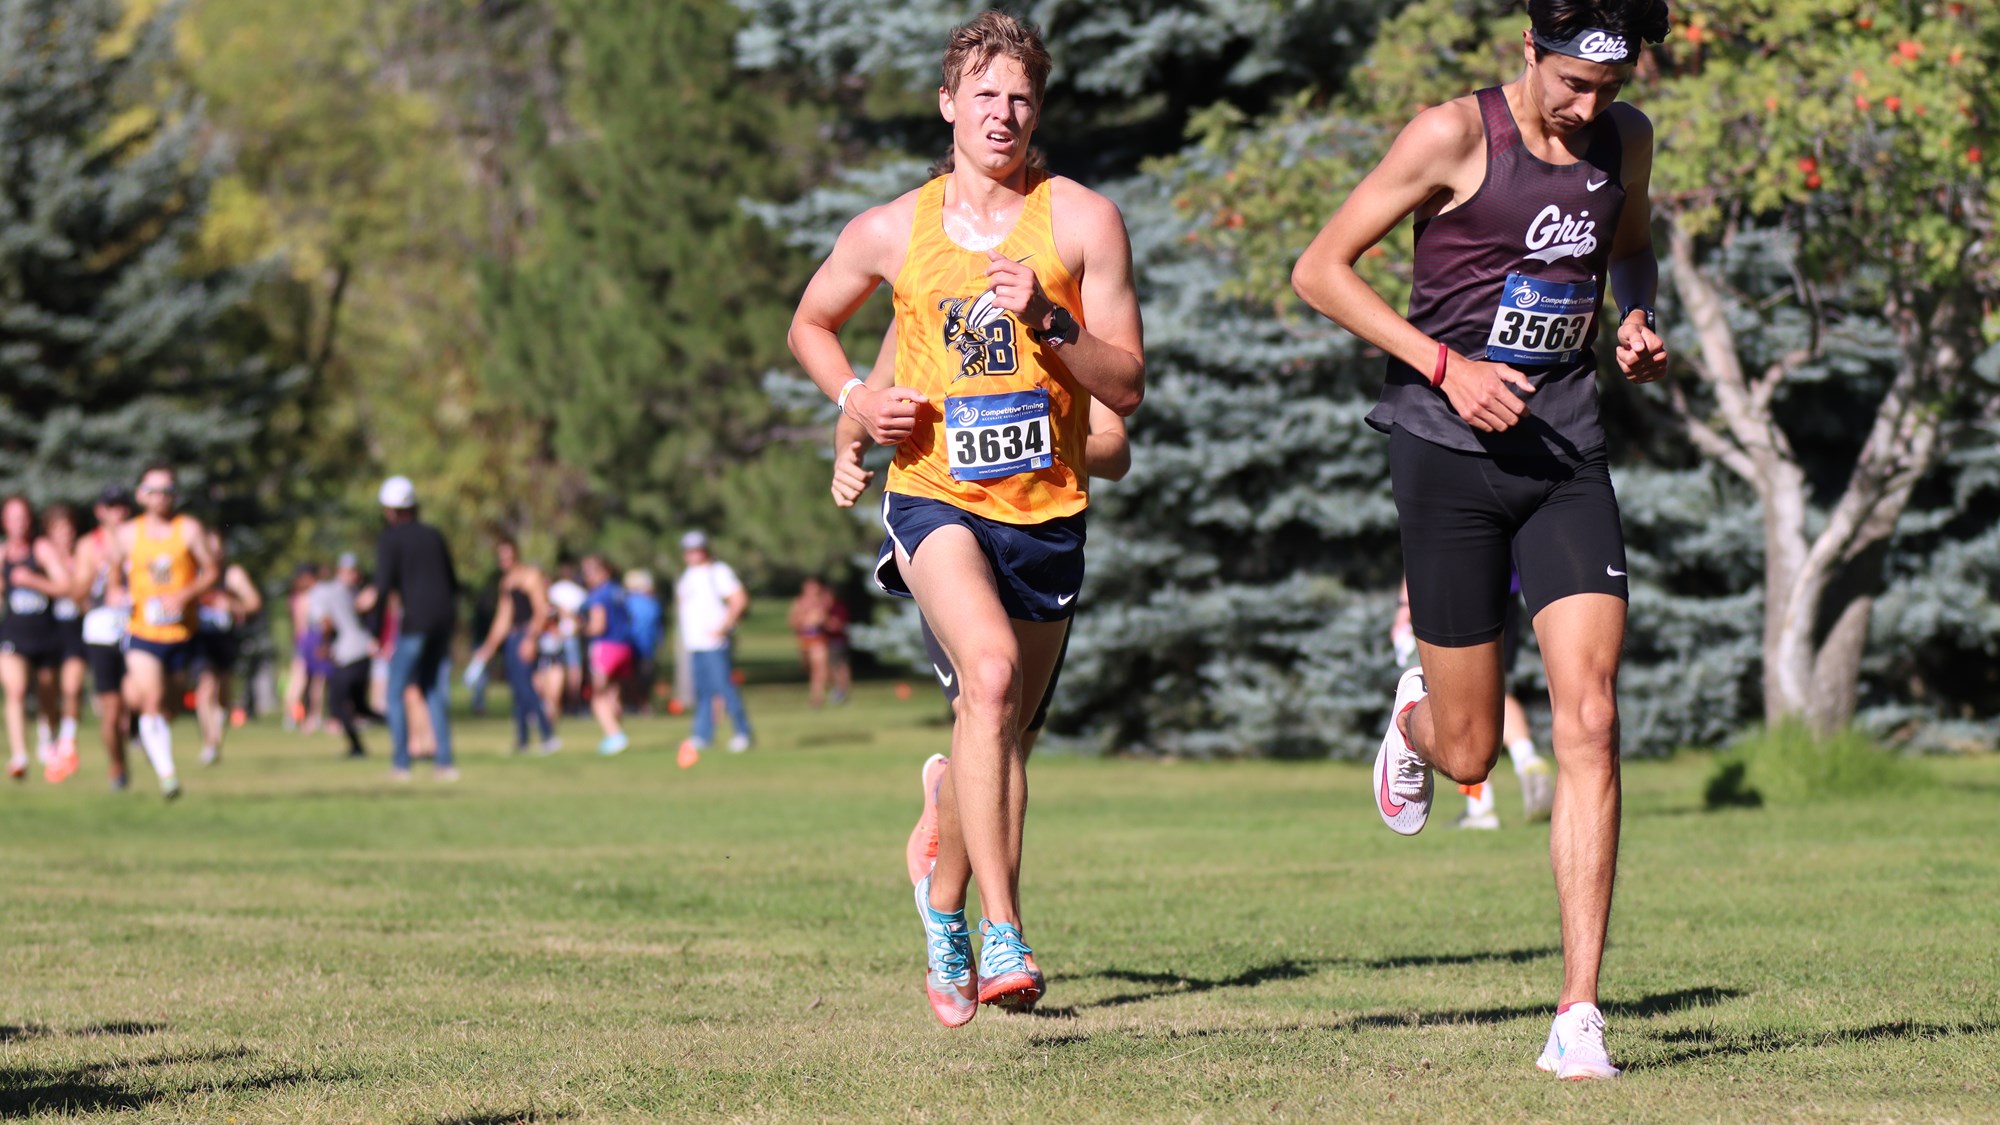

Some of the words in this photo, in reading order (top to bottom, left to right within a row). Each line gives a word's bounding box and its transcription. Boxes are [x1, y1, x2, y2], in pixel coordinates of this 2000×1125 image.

[1578, 31, 1628, 62] Griz
[1523, 204, 1597, 265] Griz
[1498, 311, 1586, 350] 3563
[980, 405, 1021, 417] Competitive
[1021, 402, 1044, 411] Timing
[955, 420, 1044, 465] 3634
